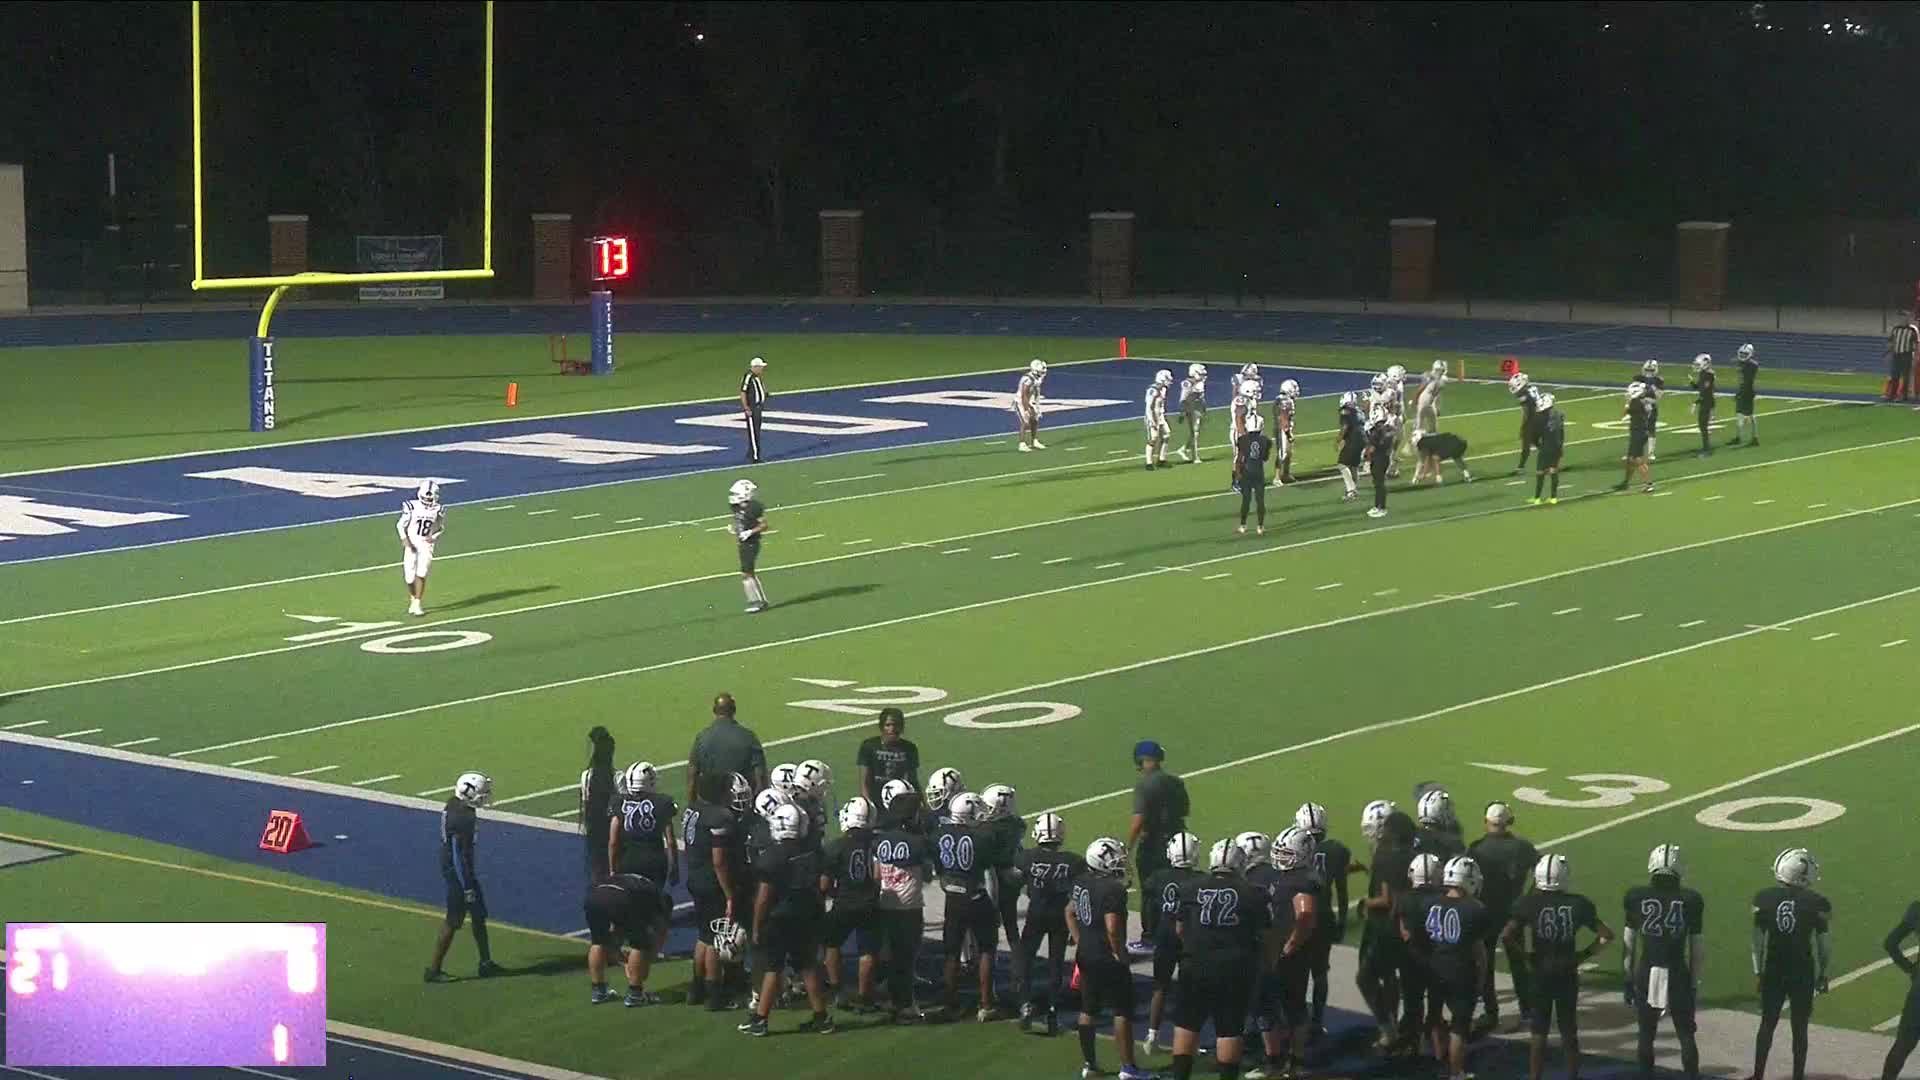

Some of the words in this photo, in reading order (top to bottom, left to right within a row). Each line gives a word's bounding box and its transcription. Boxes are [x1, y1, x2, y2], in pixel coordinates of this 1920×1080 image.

[602, 238, 628, 276] 13
[263, 343, 274, 429] TITANS
[416, 519, 432, 537] 18
[263, 815, 292, 847] 20
[622, 800, 656, 832] 78
[939, 833, 974, 871] 80
[1247, 836, 1261, 851] T
[1197, 887, 1240, 926] 72
[1425, 904, 1461, 944] 40
[1538, 905, 1573, 942] 61
[1641, 898, 1685, 937] 24
[1776, 900, 1796, 934] 6
